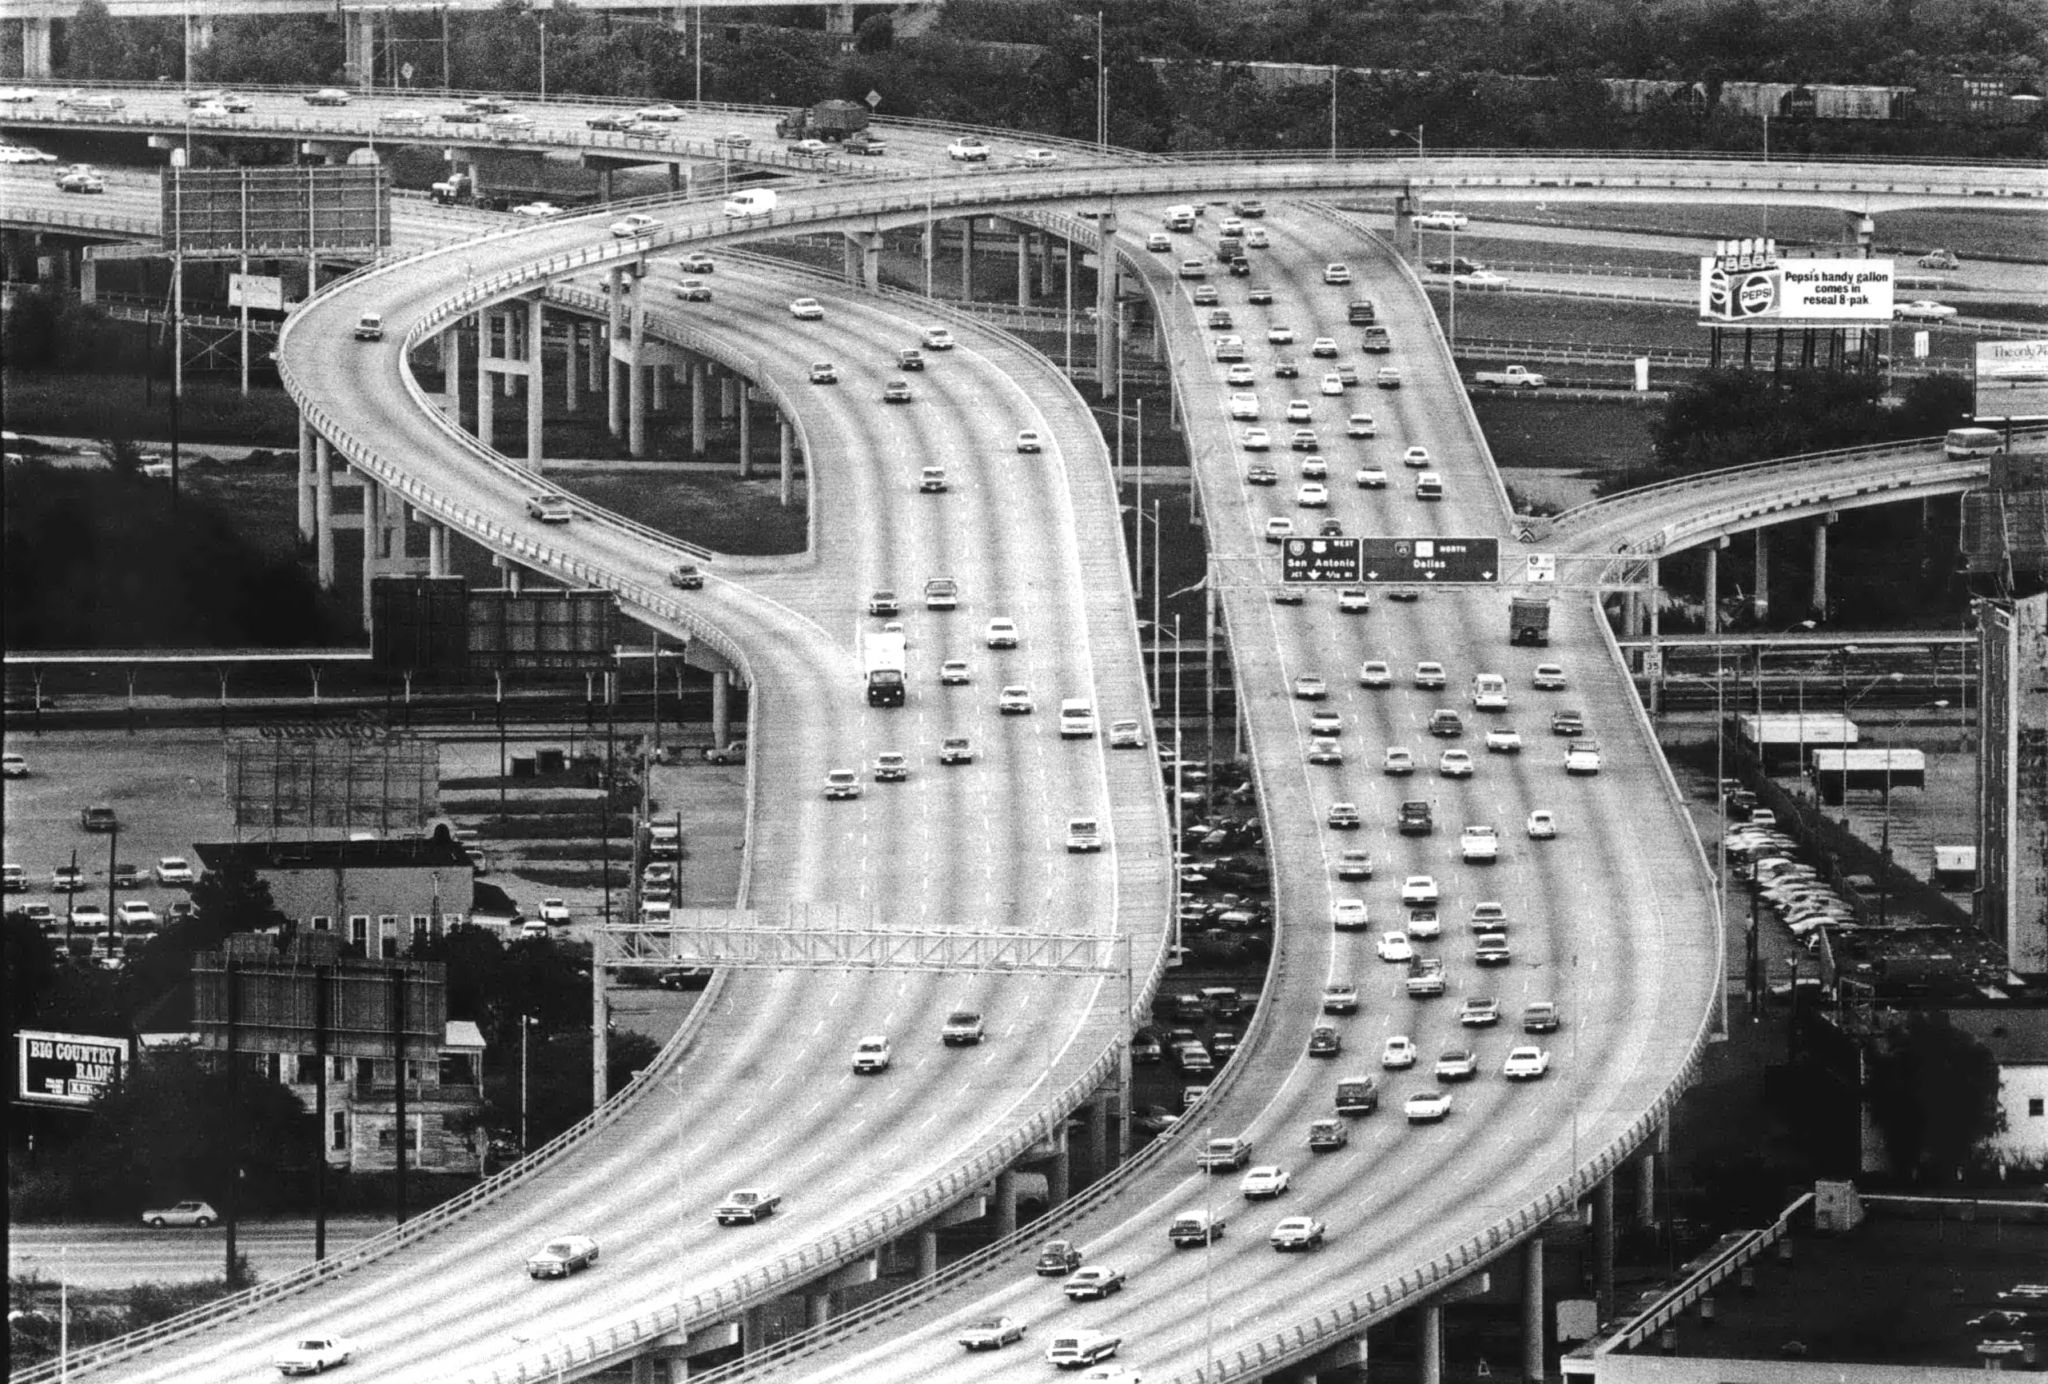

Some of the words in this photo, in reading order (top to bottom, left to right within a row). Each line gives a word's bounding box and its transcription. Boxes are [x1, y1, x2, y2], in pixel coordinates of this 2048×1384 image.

[1822, 272, 1853, 285] handy
[1856, 272, 1888, 284] gallon
[1815, 284, 1849, 294] comes
[1851, 283, 1861, 293] in
[1741, 287, 1772, 302] PEPSI
[1803, 294, 1837, 305] reseal
[1314, 558, 1356, 567] Antonio
[1413, 559, 1446, 569] Dallas
[31, 1041, 53, 1058] BIG
[56, 1043, 115, 1064] COUNTRY
